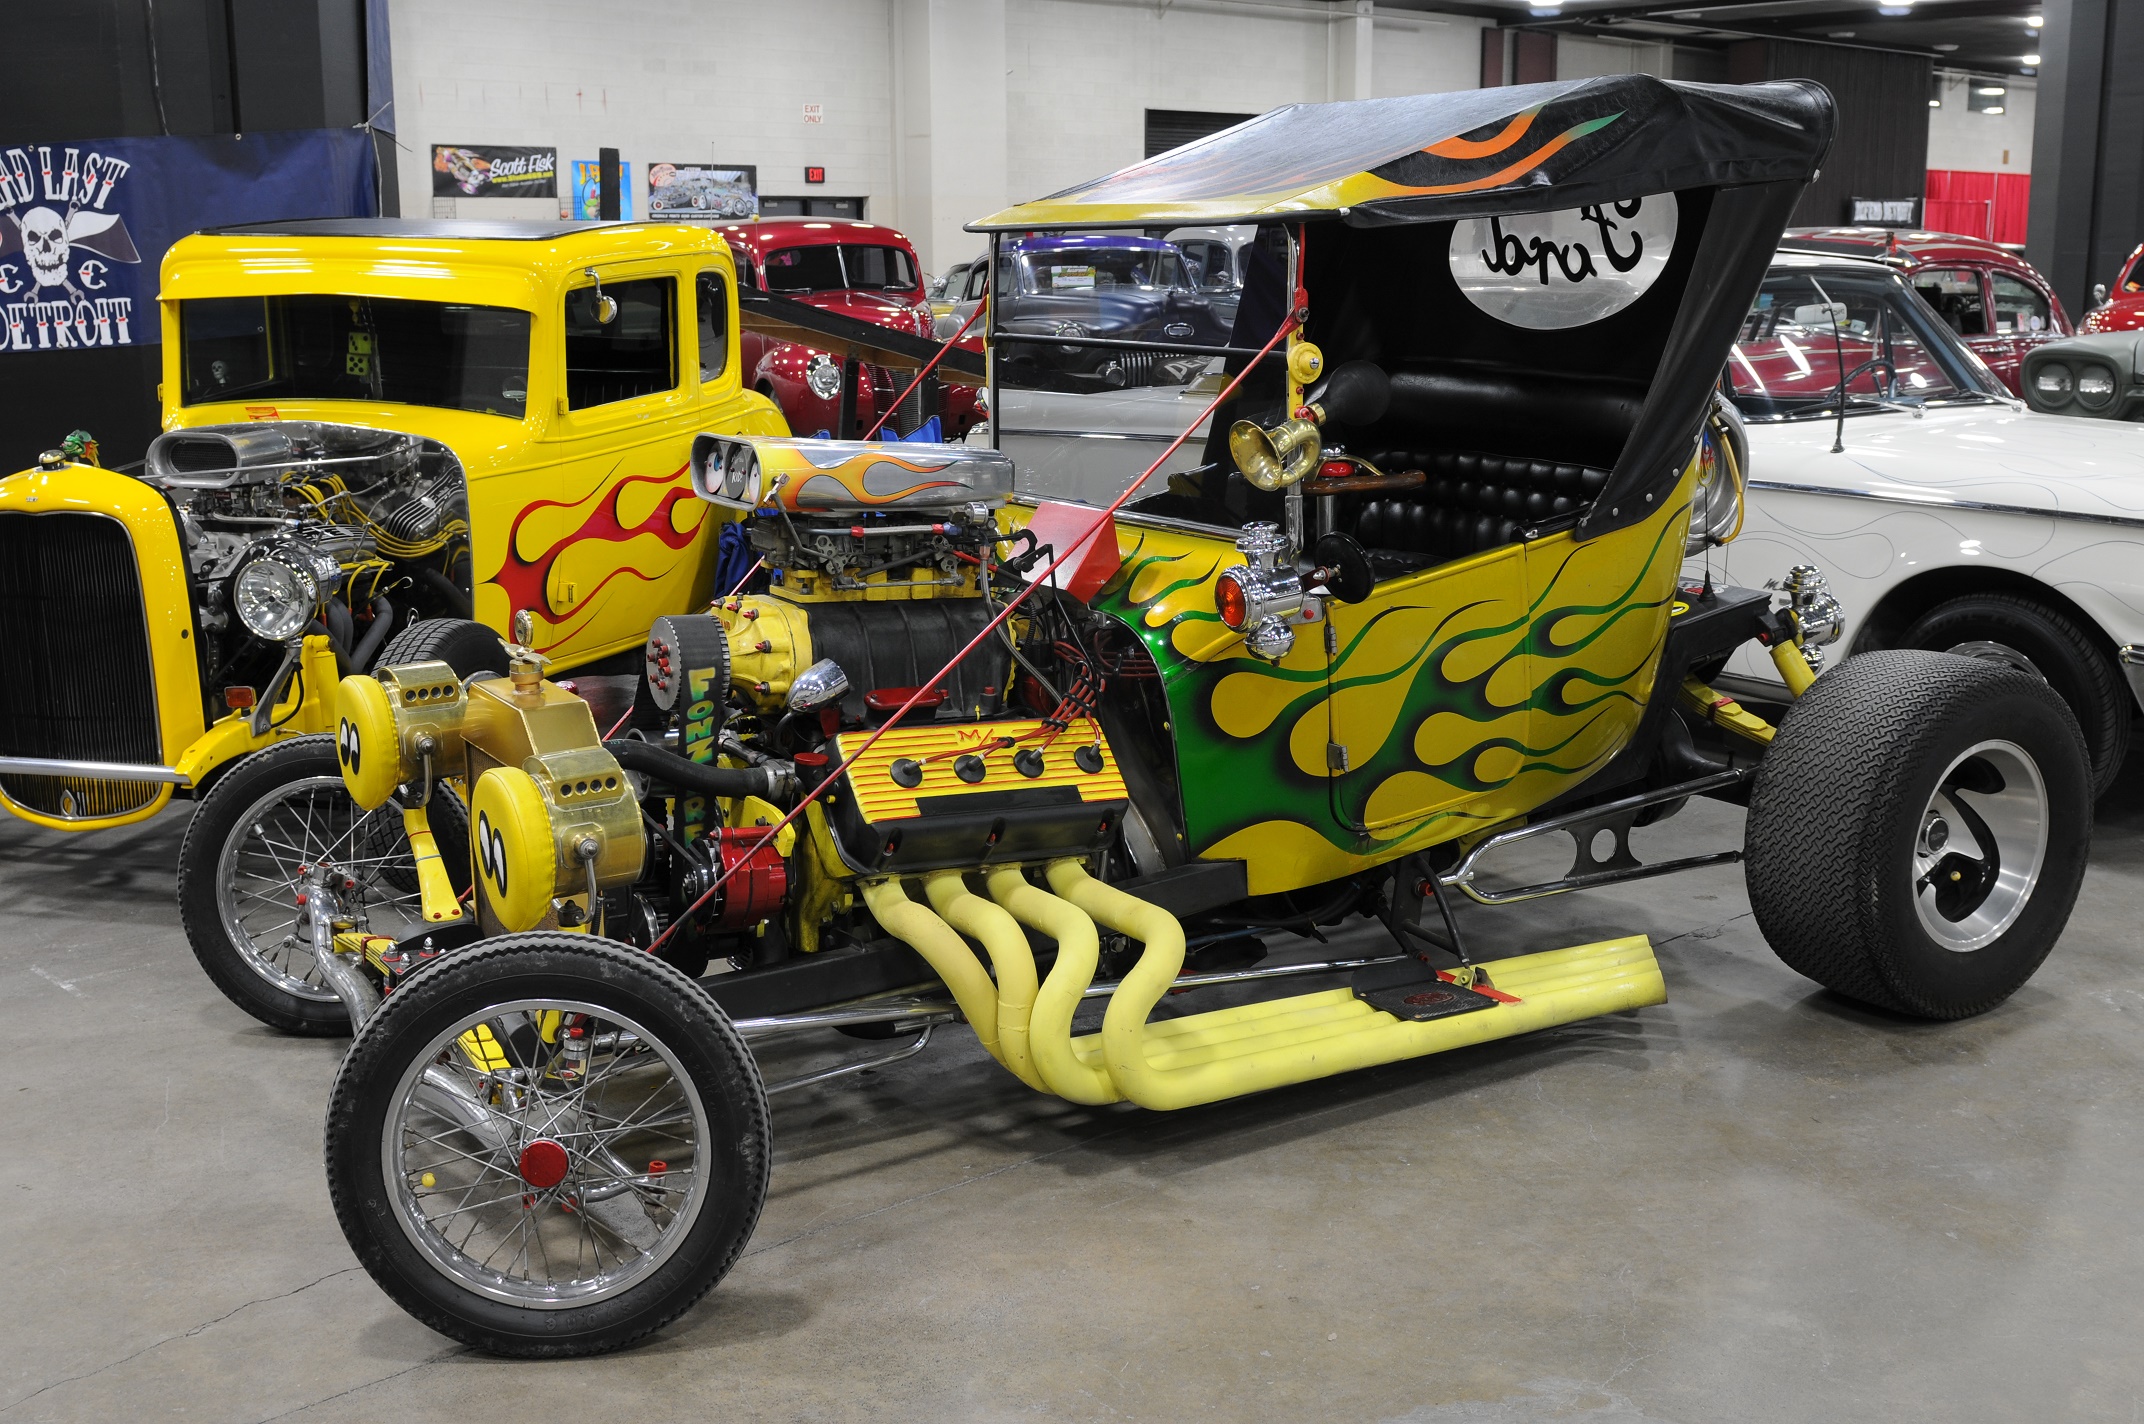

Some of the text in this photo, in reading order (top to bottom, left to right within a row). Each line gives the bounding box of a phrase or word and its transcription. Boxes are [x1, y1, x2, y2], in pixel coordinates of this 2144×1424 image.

[804, 104, 820, 113] EXIT
[804, 114, 822, 123] ONLY
[490, 152, 555, 177] Scott Fisk
[808, 167, 823, 182] EXIT
[0, 146, 131, 210] AD LAST
[78, 259, 109, 290] C
